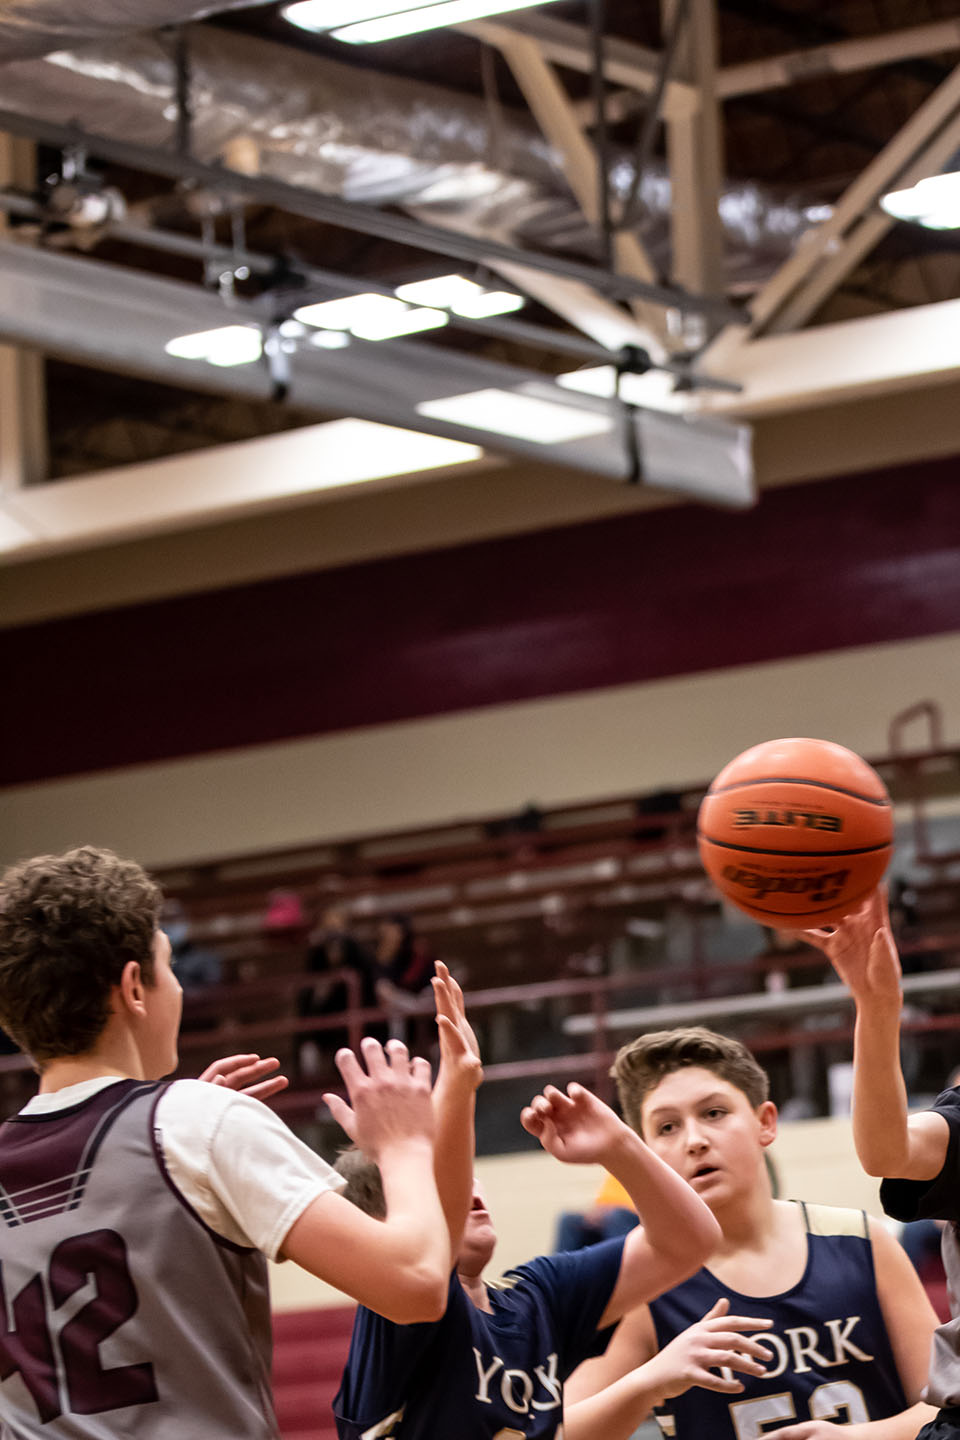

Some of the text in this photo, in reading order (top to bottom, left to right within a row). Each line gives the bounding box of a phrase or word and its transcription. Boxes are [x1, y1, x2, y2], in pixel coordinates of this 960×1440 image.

[734, 809, 843, 833] ELITE
[473, 1346, 563, 1420] YOK
[719, 1316, 875, 1383] ORK
